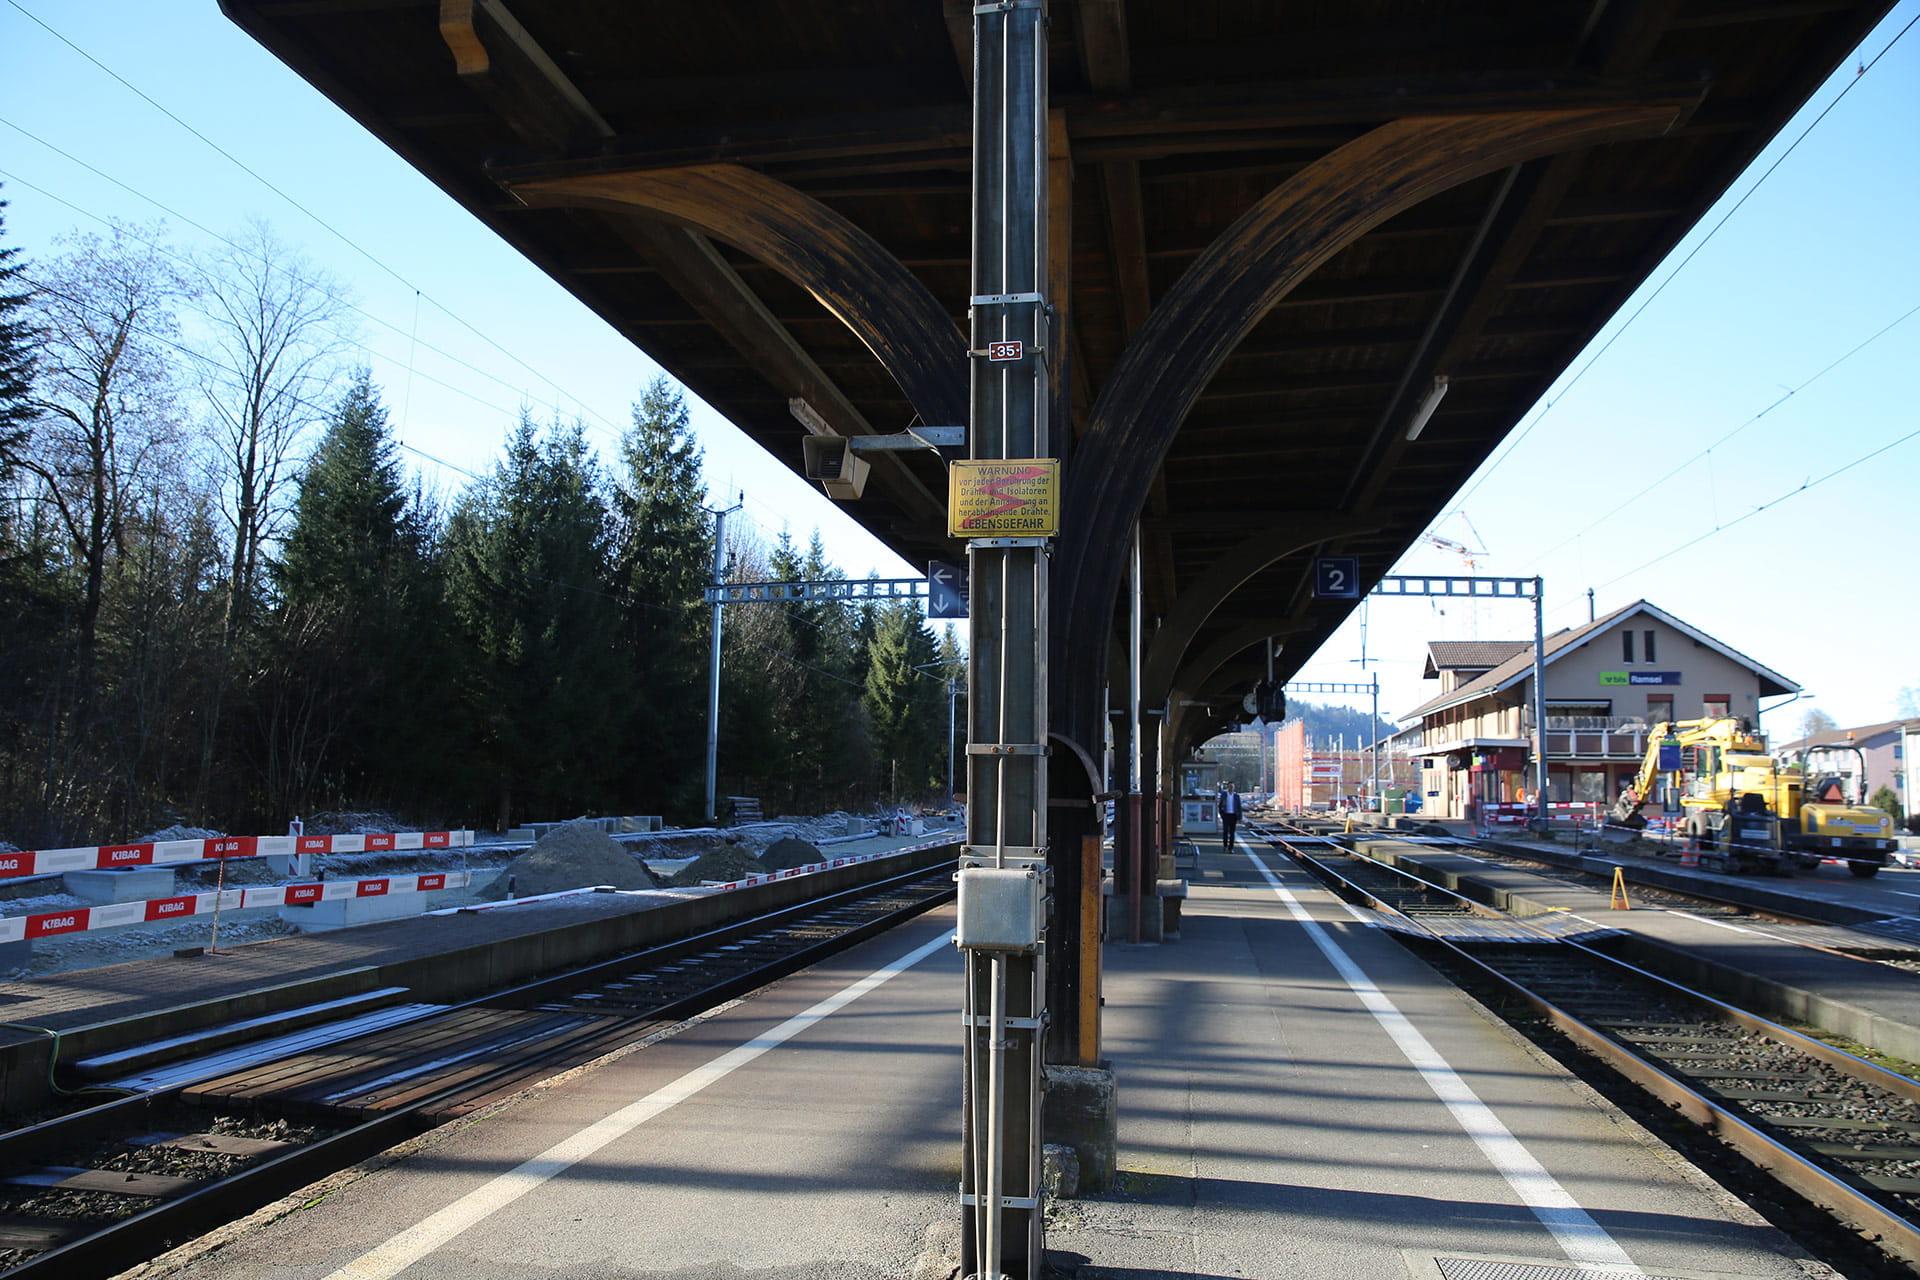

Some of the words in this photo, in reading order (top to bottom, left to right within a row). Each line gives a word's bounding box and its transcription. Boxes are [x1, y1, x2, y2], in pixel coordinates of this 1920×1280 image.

[997, 345, 1015, 357] 35
[977, 466, 1032, 475] WARNUNG
[973, 478, 993, 487] jeder
[1037, 477, 1049, 485] der
[989, 487, 1004, 495] und
[1007, 487, 1047, 495] Isolatoren
[960, 498, 973, 506] und
[975, 498, 987, 506] der
[962, 518, 1044, 529] LEBENSGEFAHR
[1329, 570, 1345, 591] 2
[305, 840, 324, 848] KIBAG
[372, 838, 389, 846] KIBAG
[429, 836, 444, 844] KIBAG
[111, 850, 140, 861] KIBAG
[424, 878, 439, 886] KIBAG
[364, 883, 382, 891] KIBAG
[294, 889, 315, 898] KIBAG
[158, 902, 185, 914] KIBAG
[42, 916, 75, 930] KIBAG
